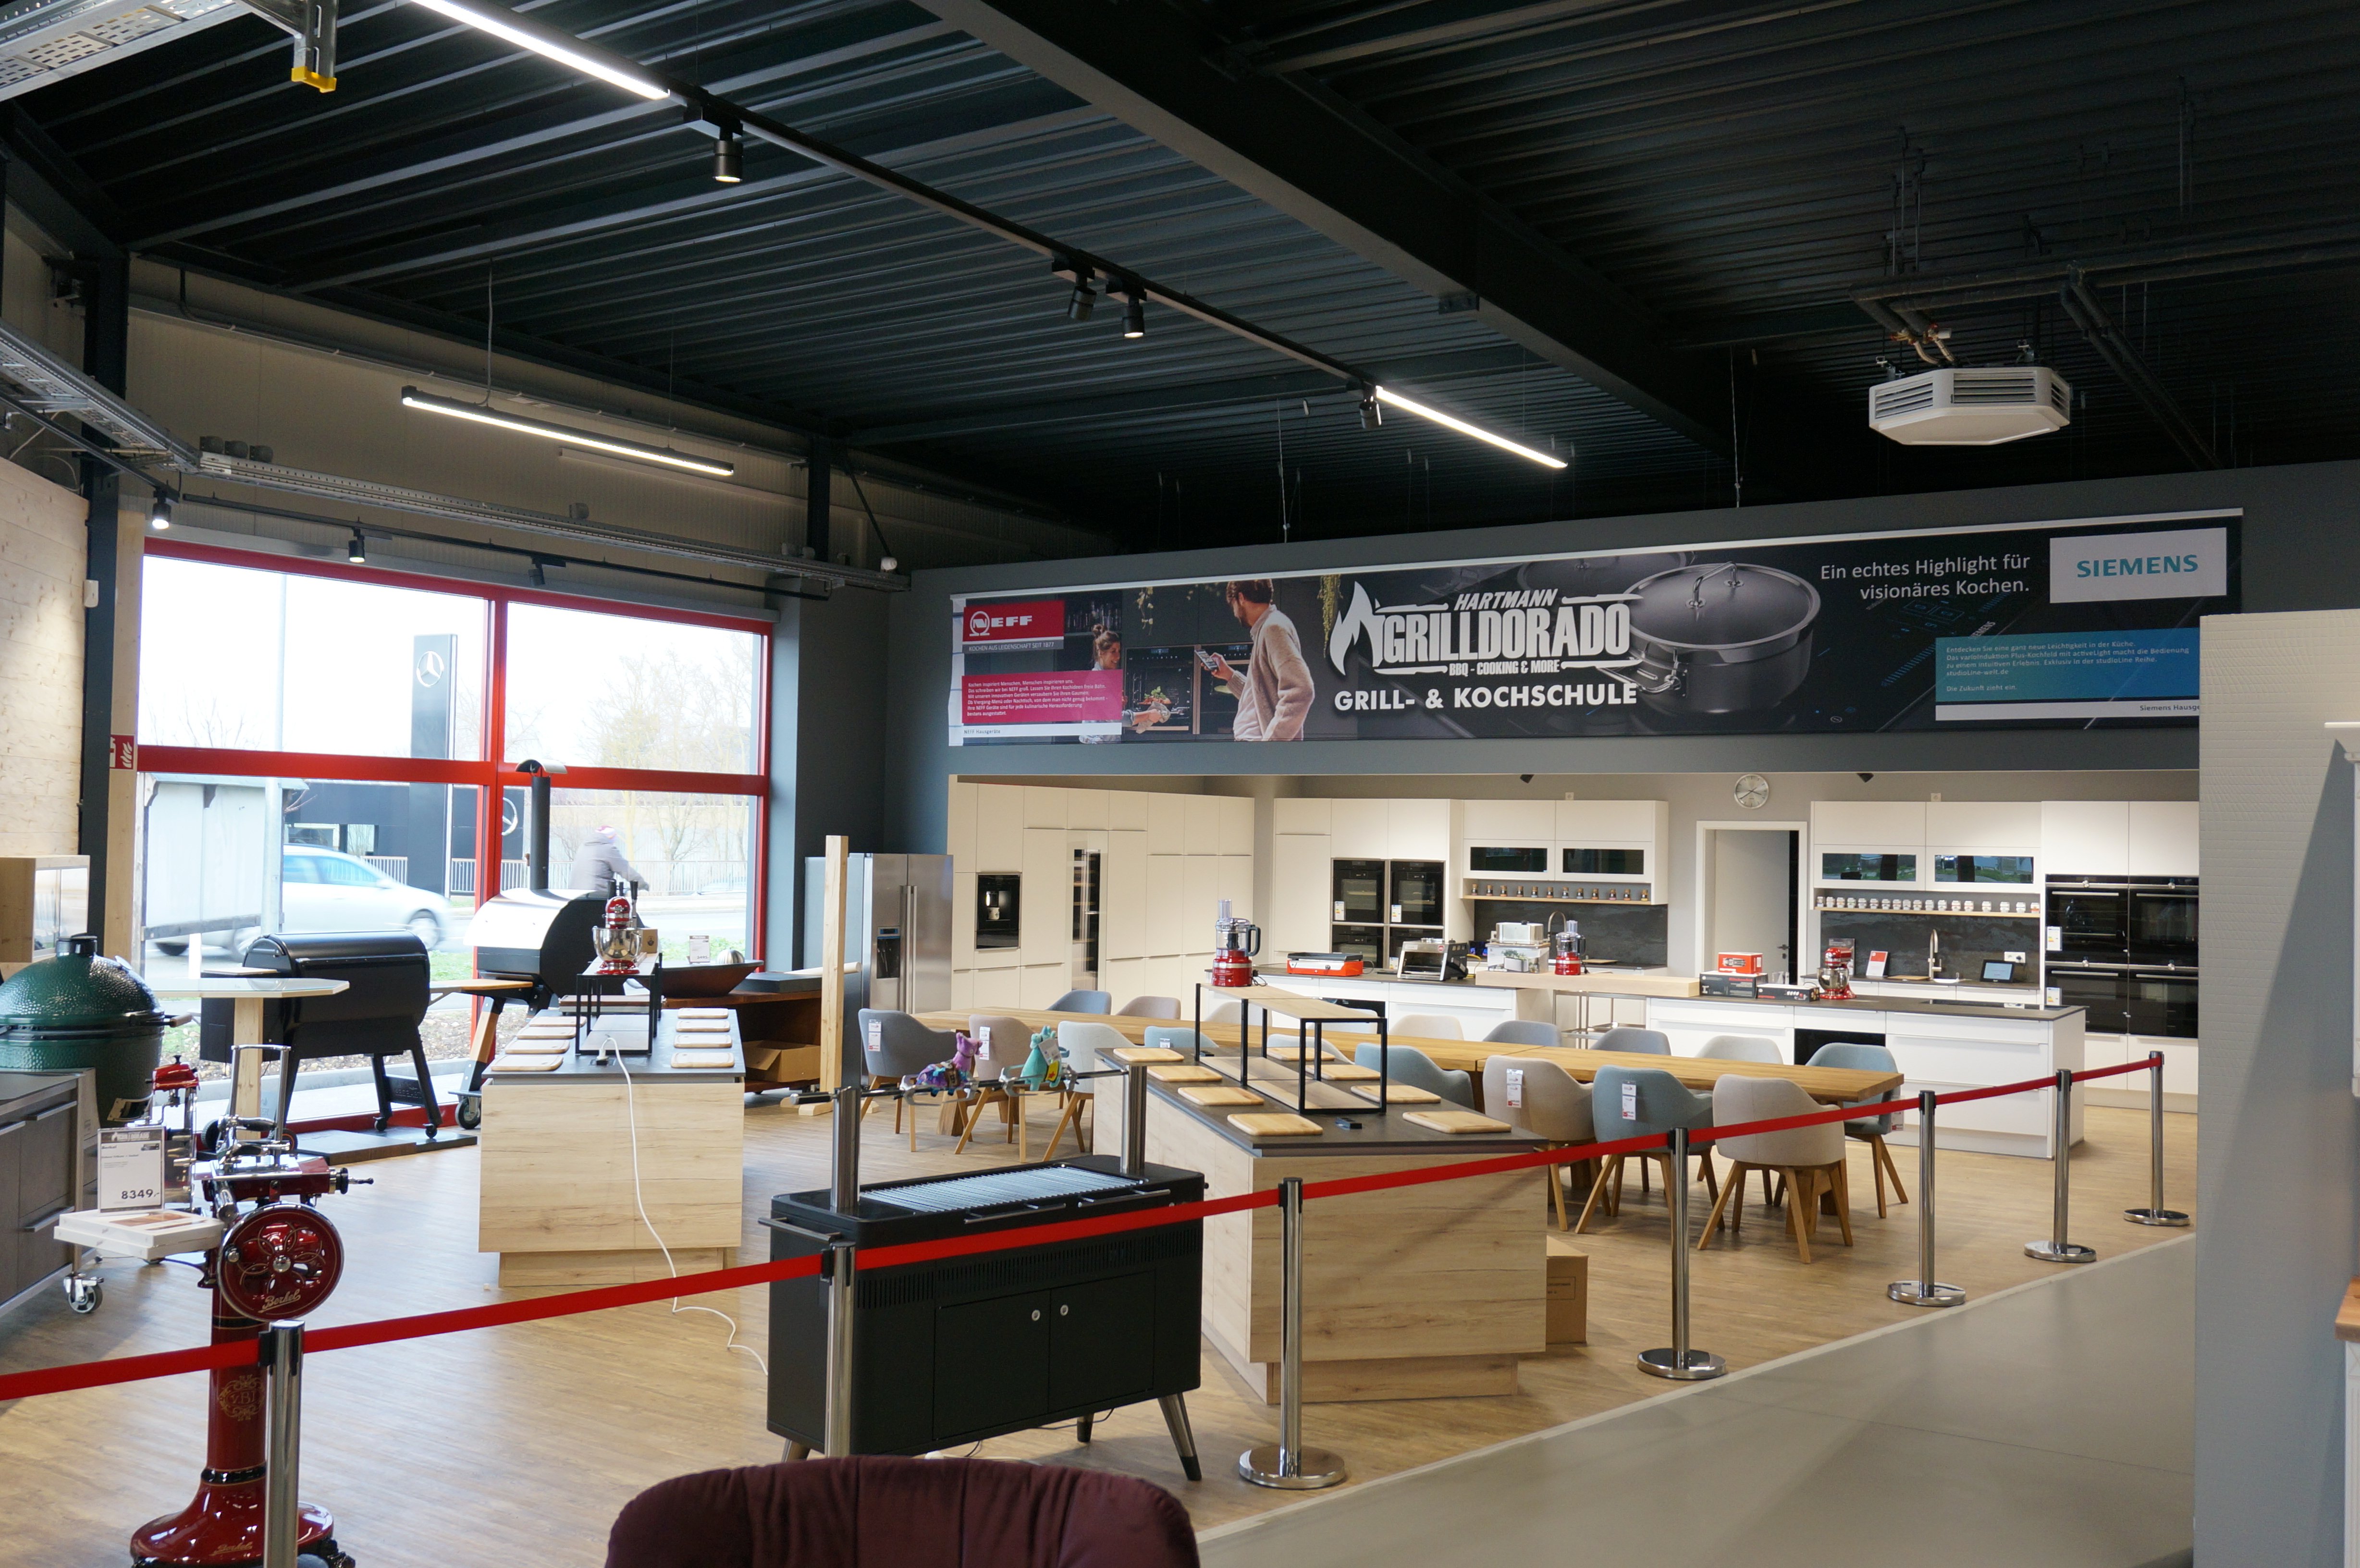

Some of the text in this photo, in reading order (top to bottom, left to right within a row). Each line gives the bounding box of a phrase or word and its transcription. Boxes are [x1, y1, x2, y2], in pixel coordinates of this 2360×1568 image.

[1821, 554, 2030, 579] Ein echtes Highlight für
[2077, 554, 2198, 577] SIEMENS
[1454, 588, 1558, 611] HARTMANN
[1860, 578, 2029, 600] visionäres Kochen.
[973, 615, 1032, 628] NEFF
[1384, 603, 1630, 663] GRILLDORADO
[1449, 662, 1468, 676] BBQ
[1477, 662, 1519, 675] COOKING
[1521, 661, 1528, 673] &
[1531, 660, 1560, 673] MORE
[1335, 683, 1637, 710] GRILL- & KOCHSCHULE
